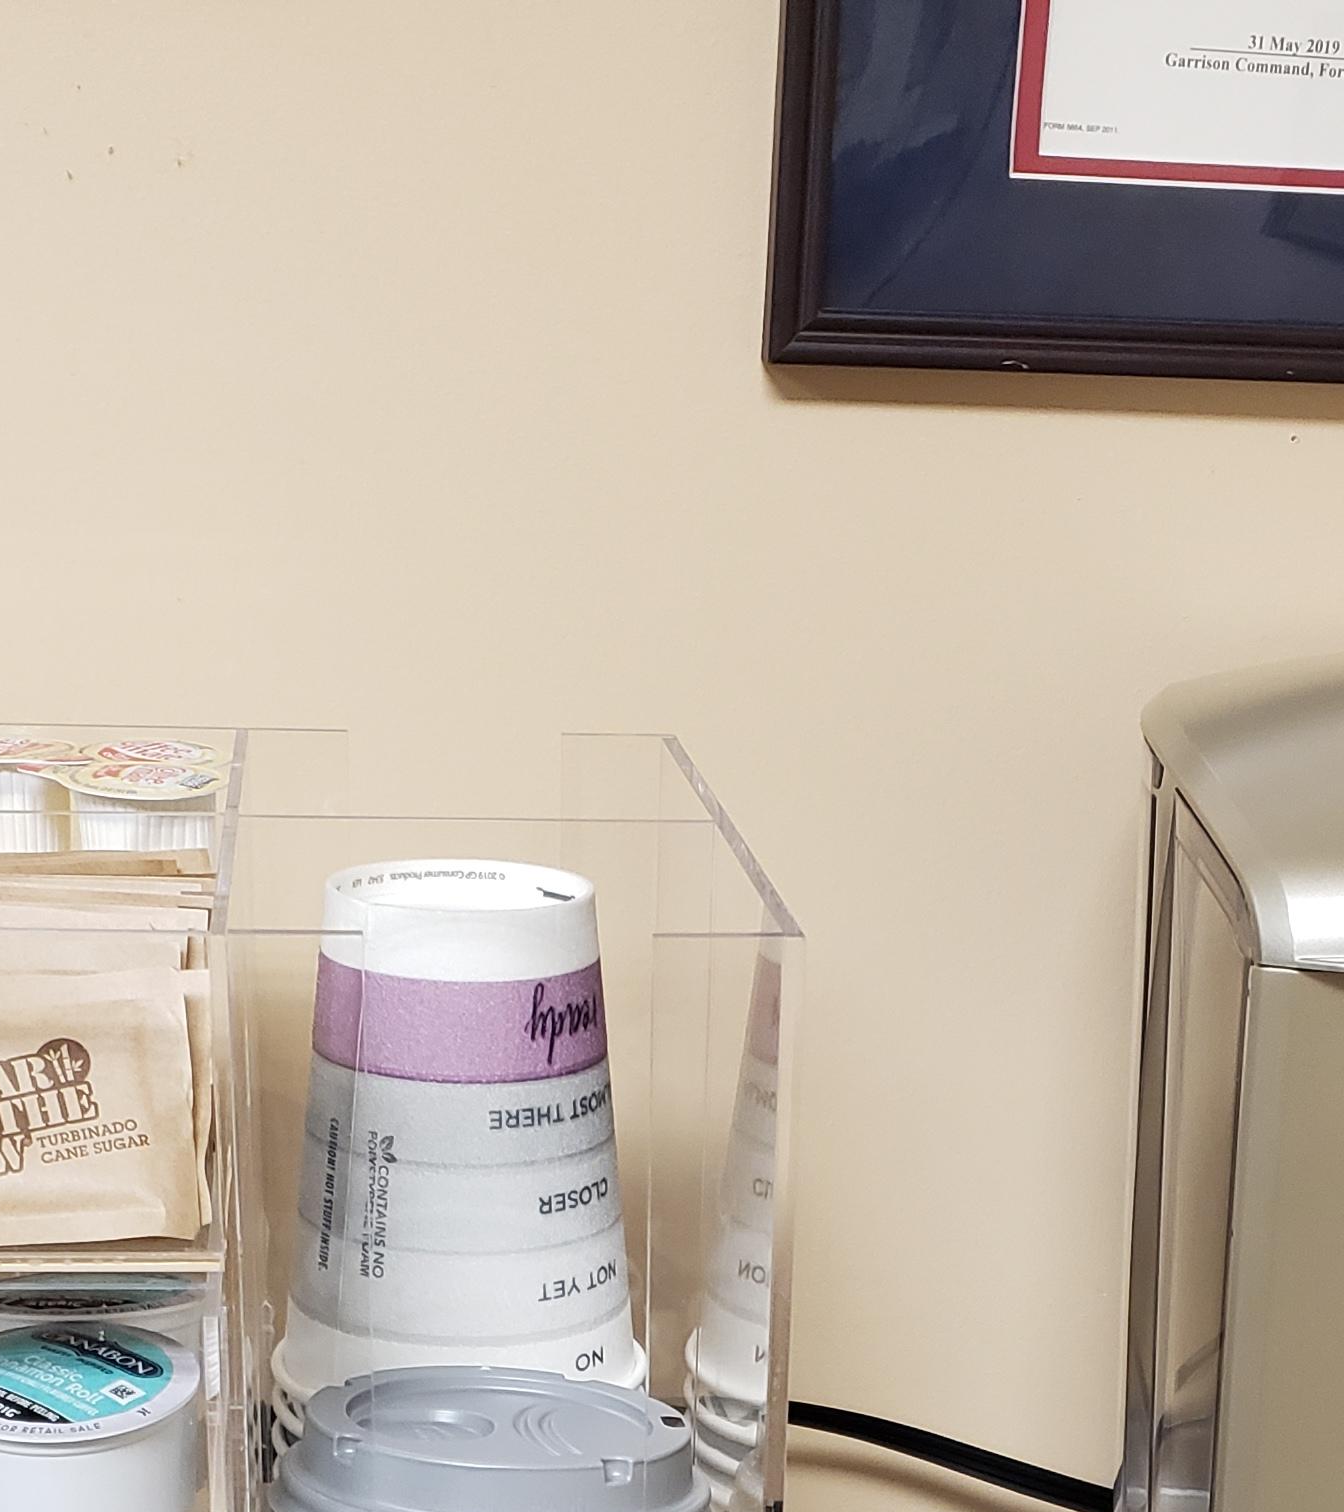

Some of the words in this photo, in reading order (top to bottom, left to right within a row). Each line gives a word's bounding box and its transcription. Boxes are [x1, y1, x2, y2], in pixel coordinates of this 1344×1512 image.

[1248, 35, 1265, 51] 31
[1270, 36, 1301, 56] May
[1307, 39, 1341, 56] 2019
[1165, 52, 1230, 72] Garrison
[1235, 57, 1315, 79] Command,
[424, 870, 464, 880] Consumer
[524, 983, 599, 1064] ready
[489, 1106, 565, 1131] THERE
[36, 1118, 138, 1149] TURBINADO
[40, 1145, 90, 1164] CANE
[93, 1134, 150, 1157] SUGAR
[324, 1173, 335, 1197] HOT
[538, 1176, 609, 1216] CLOSER
[322, 1196, 334, 1231] STUFF
[373, 1165, 390, 1248] CONTAINS
[372, 1250, 385, 1279] NO
[587, 1258, 619, 1292] NOT
[537, 1275, 582, 1302] YET
[24, 1354, 82, 1382] Classic
[575, 1344, 605, 1373] NO
[66, 1382, 104, 1405] Roll
[22, 1425, 64, 1435] RETAIL
[70, 1423, 102, 1433] SALE
